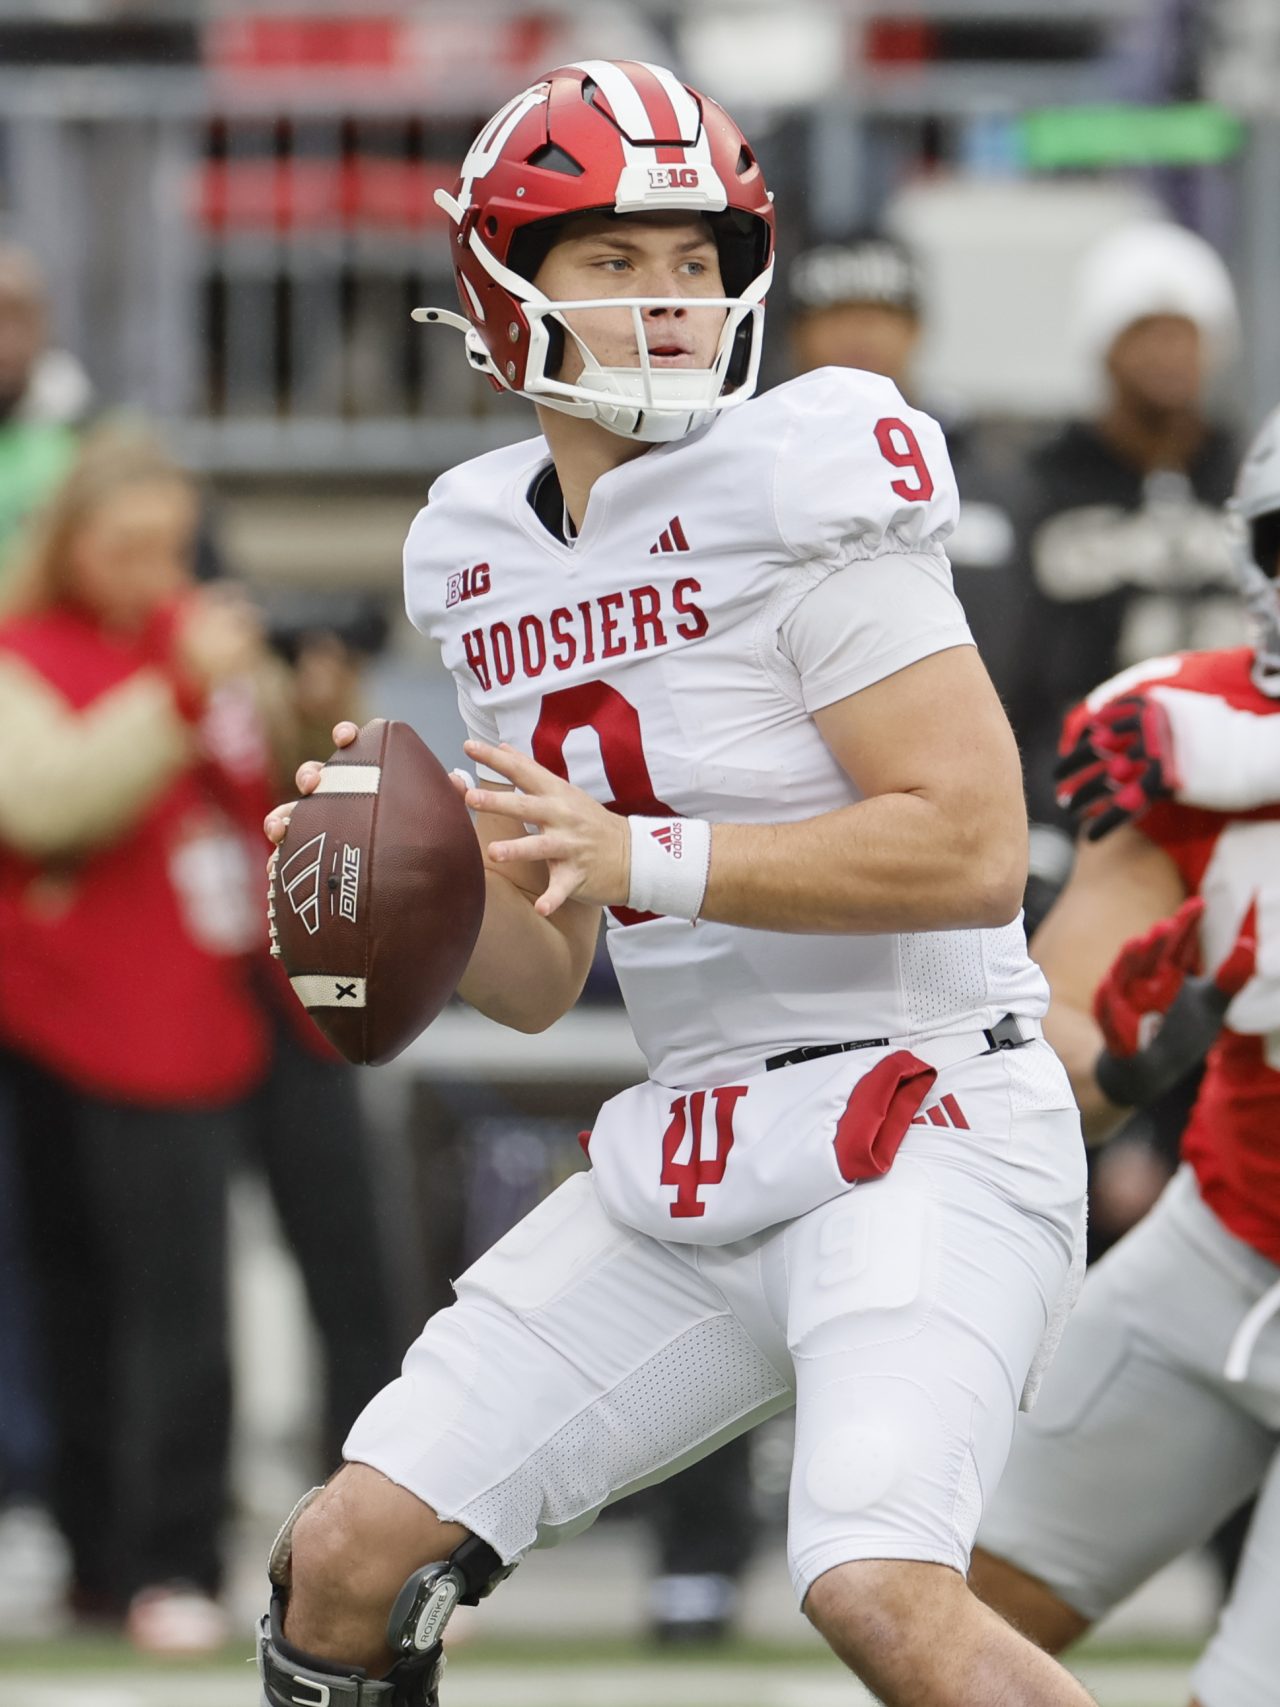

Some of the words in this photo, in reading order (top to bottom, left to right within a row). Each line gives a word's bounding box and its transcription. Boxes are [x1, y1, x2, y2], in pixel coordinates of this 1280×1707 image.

[873, 417, 935, 502] 9
[461, 577, 709, 692] HOOSIERS
[671, 822, 682, 859] adidas
[339, 843, 361, 923] DIME
[420, 1592, 447, 1643] ROURKE
